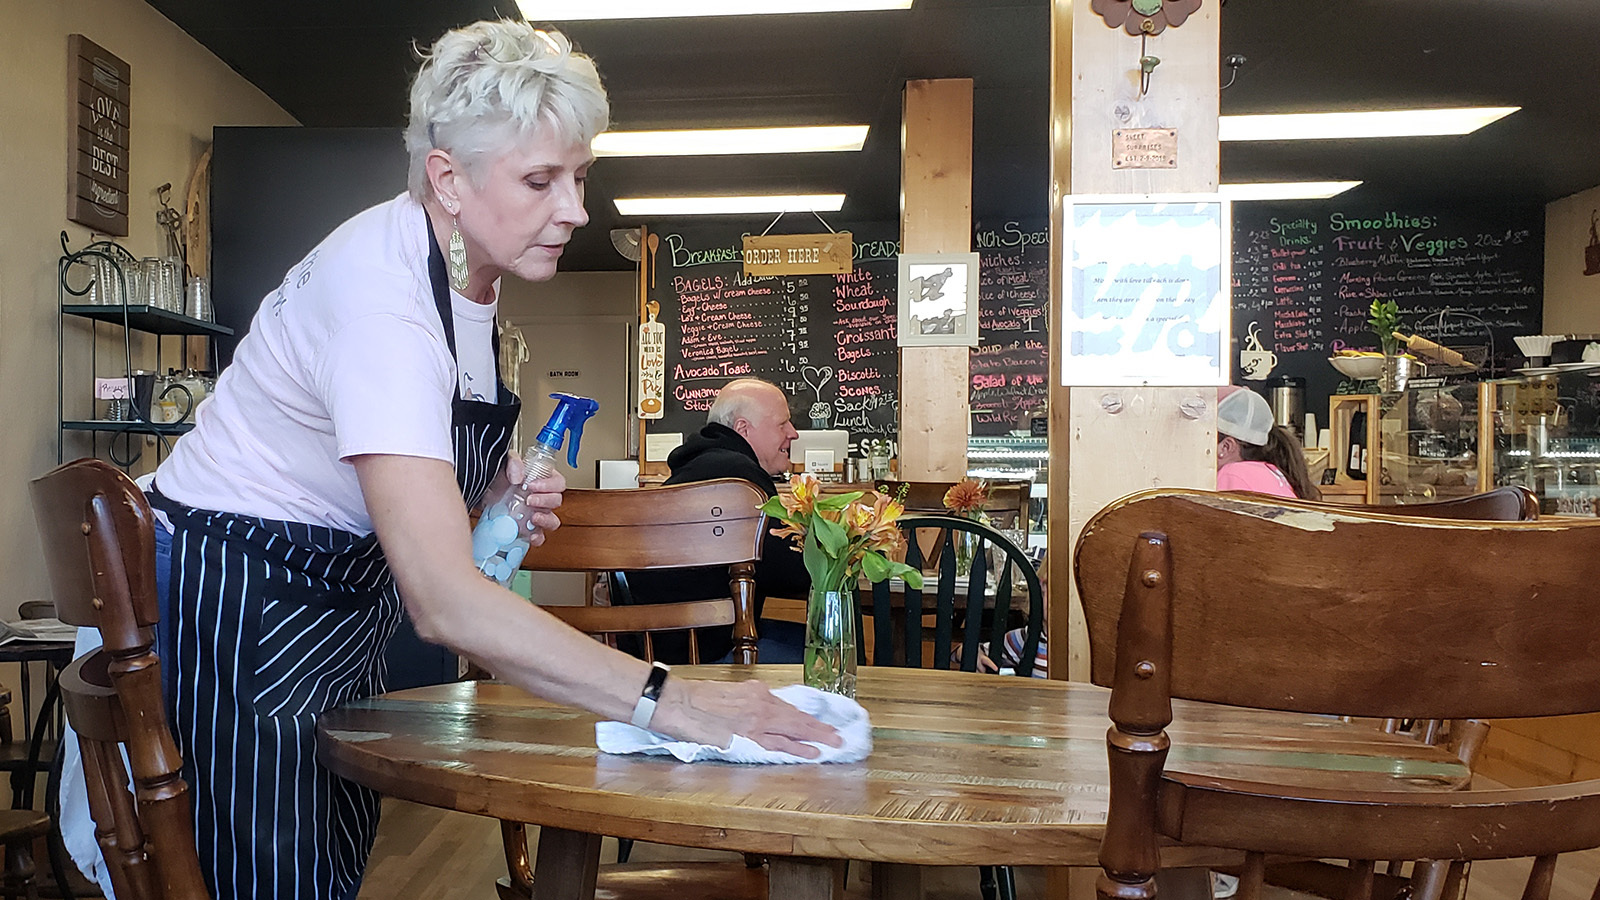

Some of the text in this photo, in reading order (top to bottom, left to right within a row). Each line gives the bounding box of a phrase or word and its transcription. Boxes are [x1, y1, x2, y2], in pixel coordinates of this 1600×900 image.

[90, 97, 119, 129] LOVE
[97, 125, 113, 145] is the
[1125, 133, 1144, 141] SWEET
[92, 145, 118, 179] BEST
[1330, 211, 1437, 231] Smoothies:
[1332, 235, 1384, 251] Fruit
[1400, 233, 1467, 256] Veggies
[746, 248, 820, 264] ORDER HERE
[836, 267, 873, 283] White
[836, 282, 874, 298] Wheat
[680, 294, 710, 307] Bagels
[836, 296, 891, 313] Sourdough
[682, 306, 695, 316] Egg
[701, 302, 727, 312] Cheese
[701, 313, 727, 322] Cream
[728, 312, 752, 320] Cheese
[681, 323, 706, 336] Veggie
[713, 322, 735, 331] Cream
[737, 321, 763, 329] Cheese
[836, 324, 898, 346] Croissant
[708, 334, 723, 342] Eve
[716, 345, 739, 356] Bagel
[837, 347, 871, 363] Bagels
[641, 354, 663, 370] Love
[674, 364, 719, 380] Avocado
[719, 362, 751, 376] Toast
[838, 368, 881, 382] Biscotti
[641, 379, 662, 395] Pie
[973, 374, 1044, 390] Salad of the
[834, 395, 872, 412] Sack
[834, 410, 874, 429] Lunch
